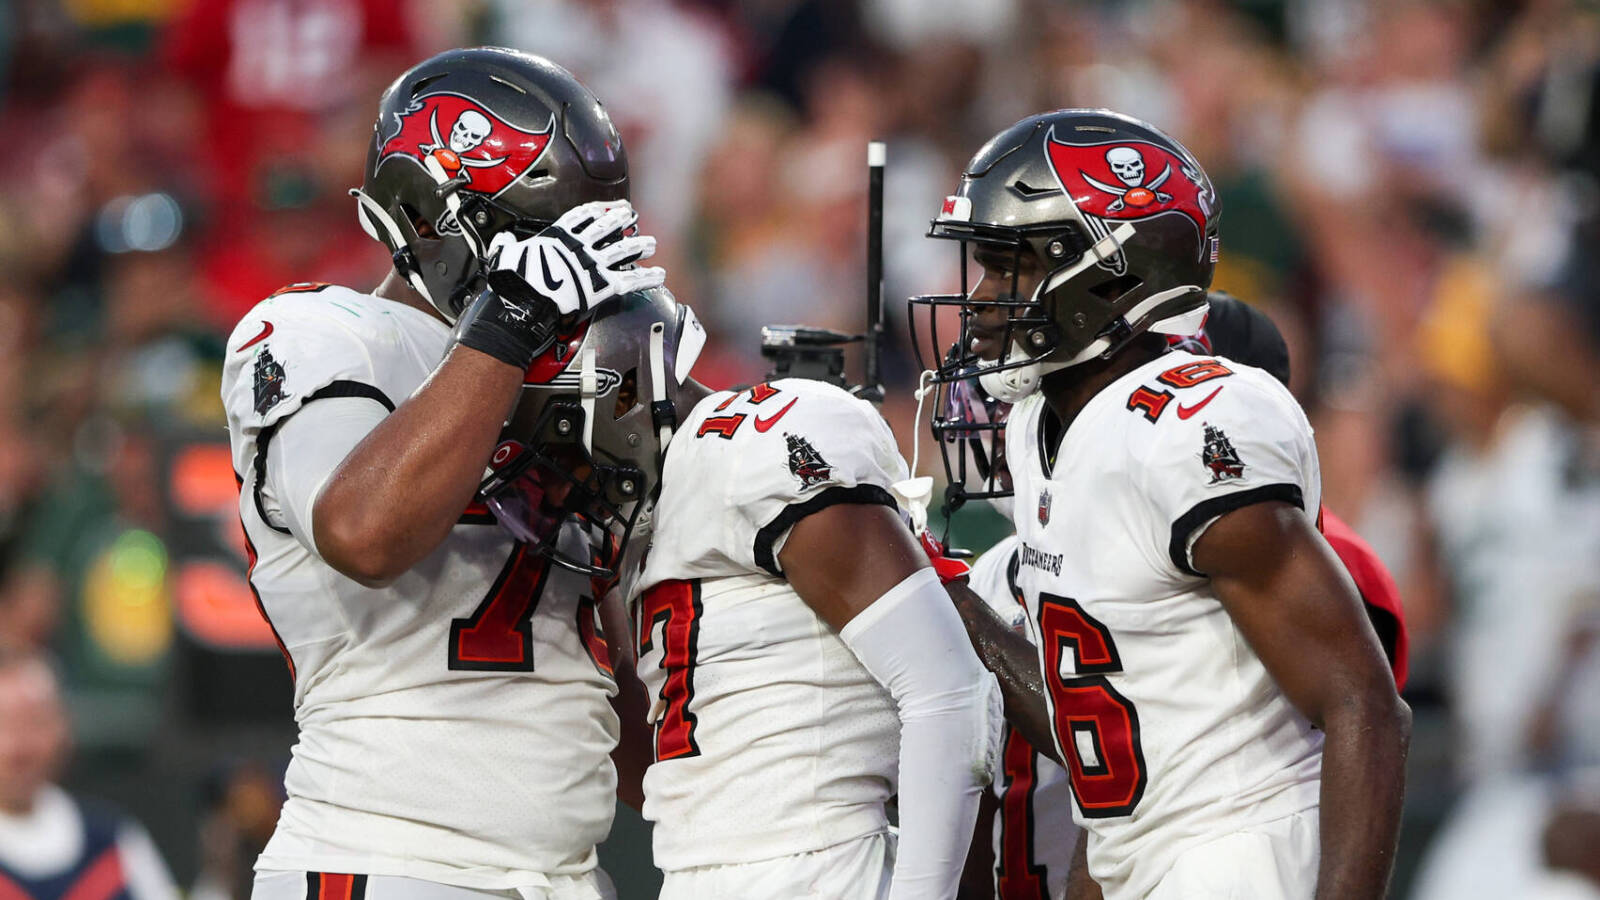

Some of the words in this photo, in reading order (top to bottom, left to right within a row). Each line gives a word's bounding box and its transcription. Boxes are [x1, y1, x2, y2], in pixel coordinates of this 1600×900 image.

[1126, 360, 1235, 424] 16
[448, 498, 615, 676] 7
[1021, 541, 1064, 577] BUCCANEERS
[632, 578, 704, 763] 7
[1036, 592, 1148, 818] 6
